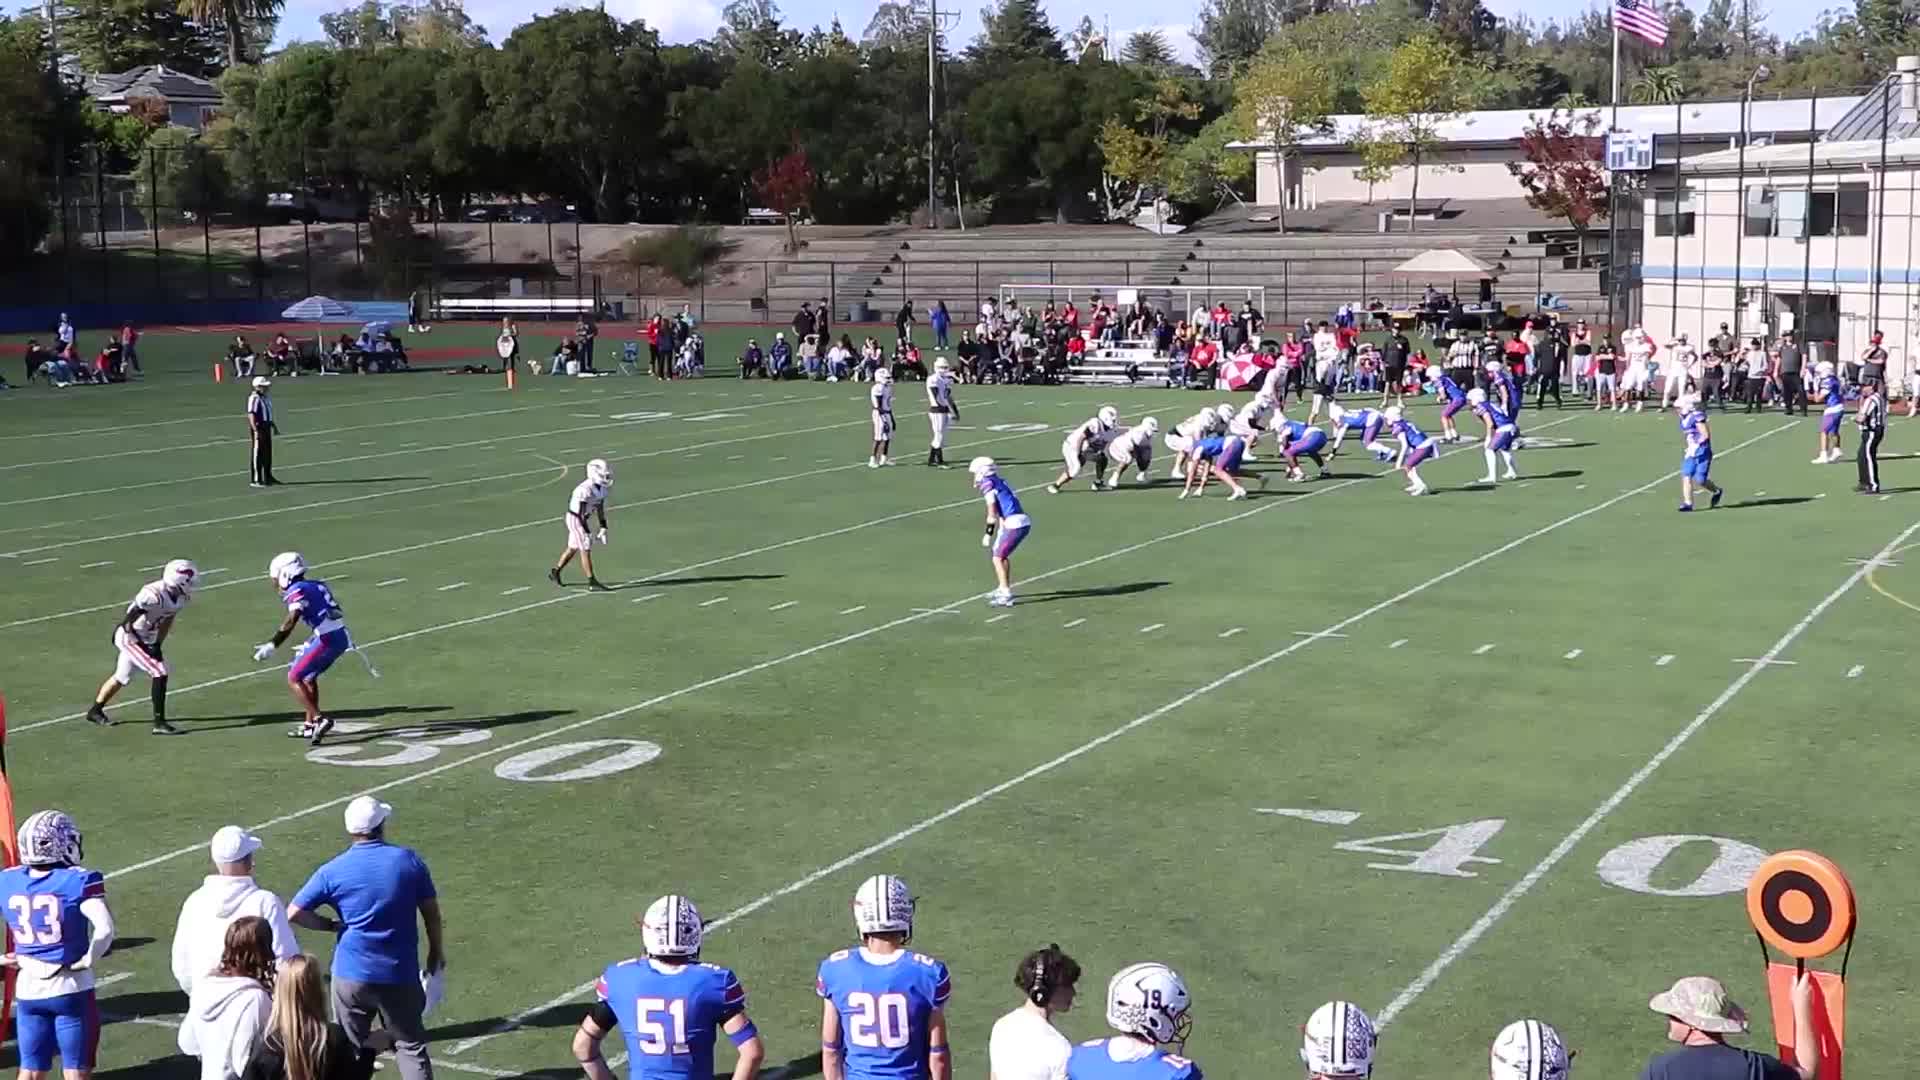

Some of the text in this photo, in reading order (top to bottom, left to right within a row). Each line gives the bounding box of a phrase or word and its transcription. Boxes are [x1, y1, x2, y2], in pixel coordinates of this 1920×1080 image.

[7, 893, 62, 945] 33
[636, 998, 690, 1055] 51
[846, 991, 909, 1049] 20
[1141, 989, 1162, 1010] 19
